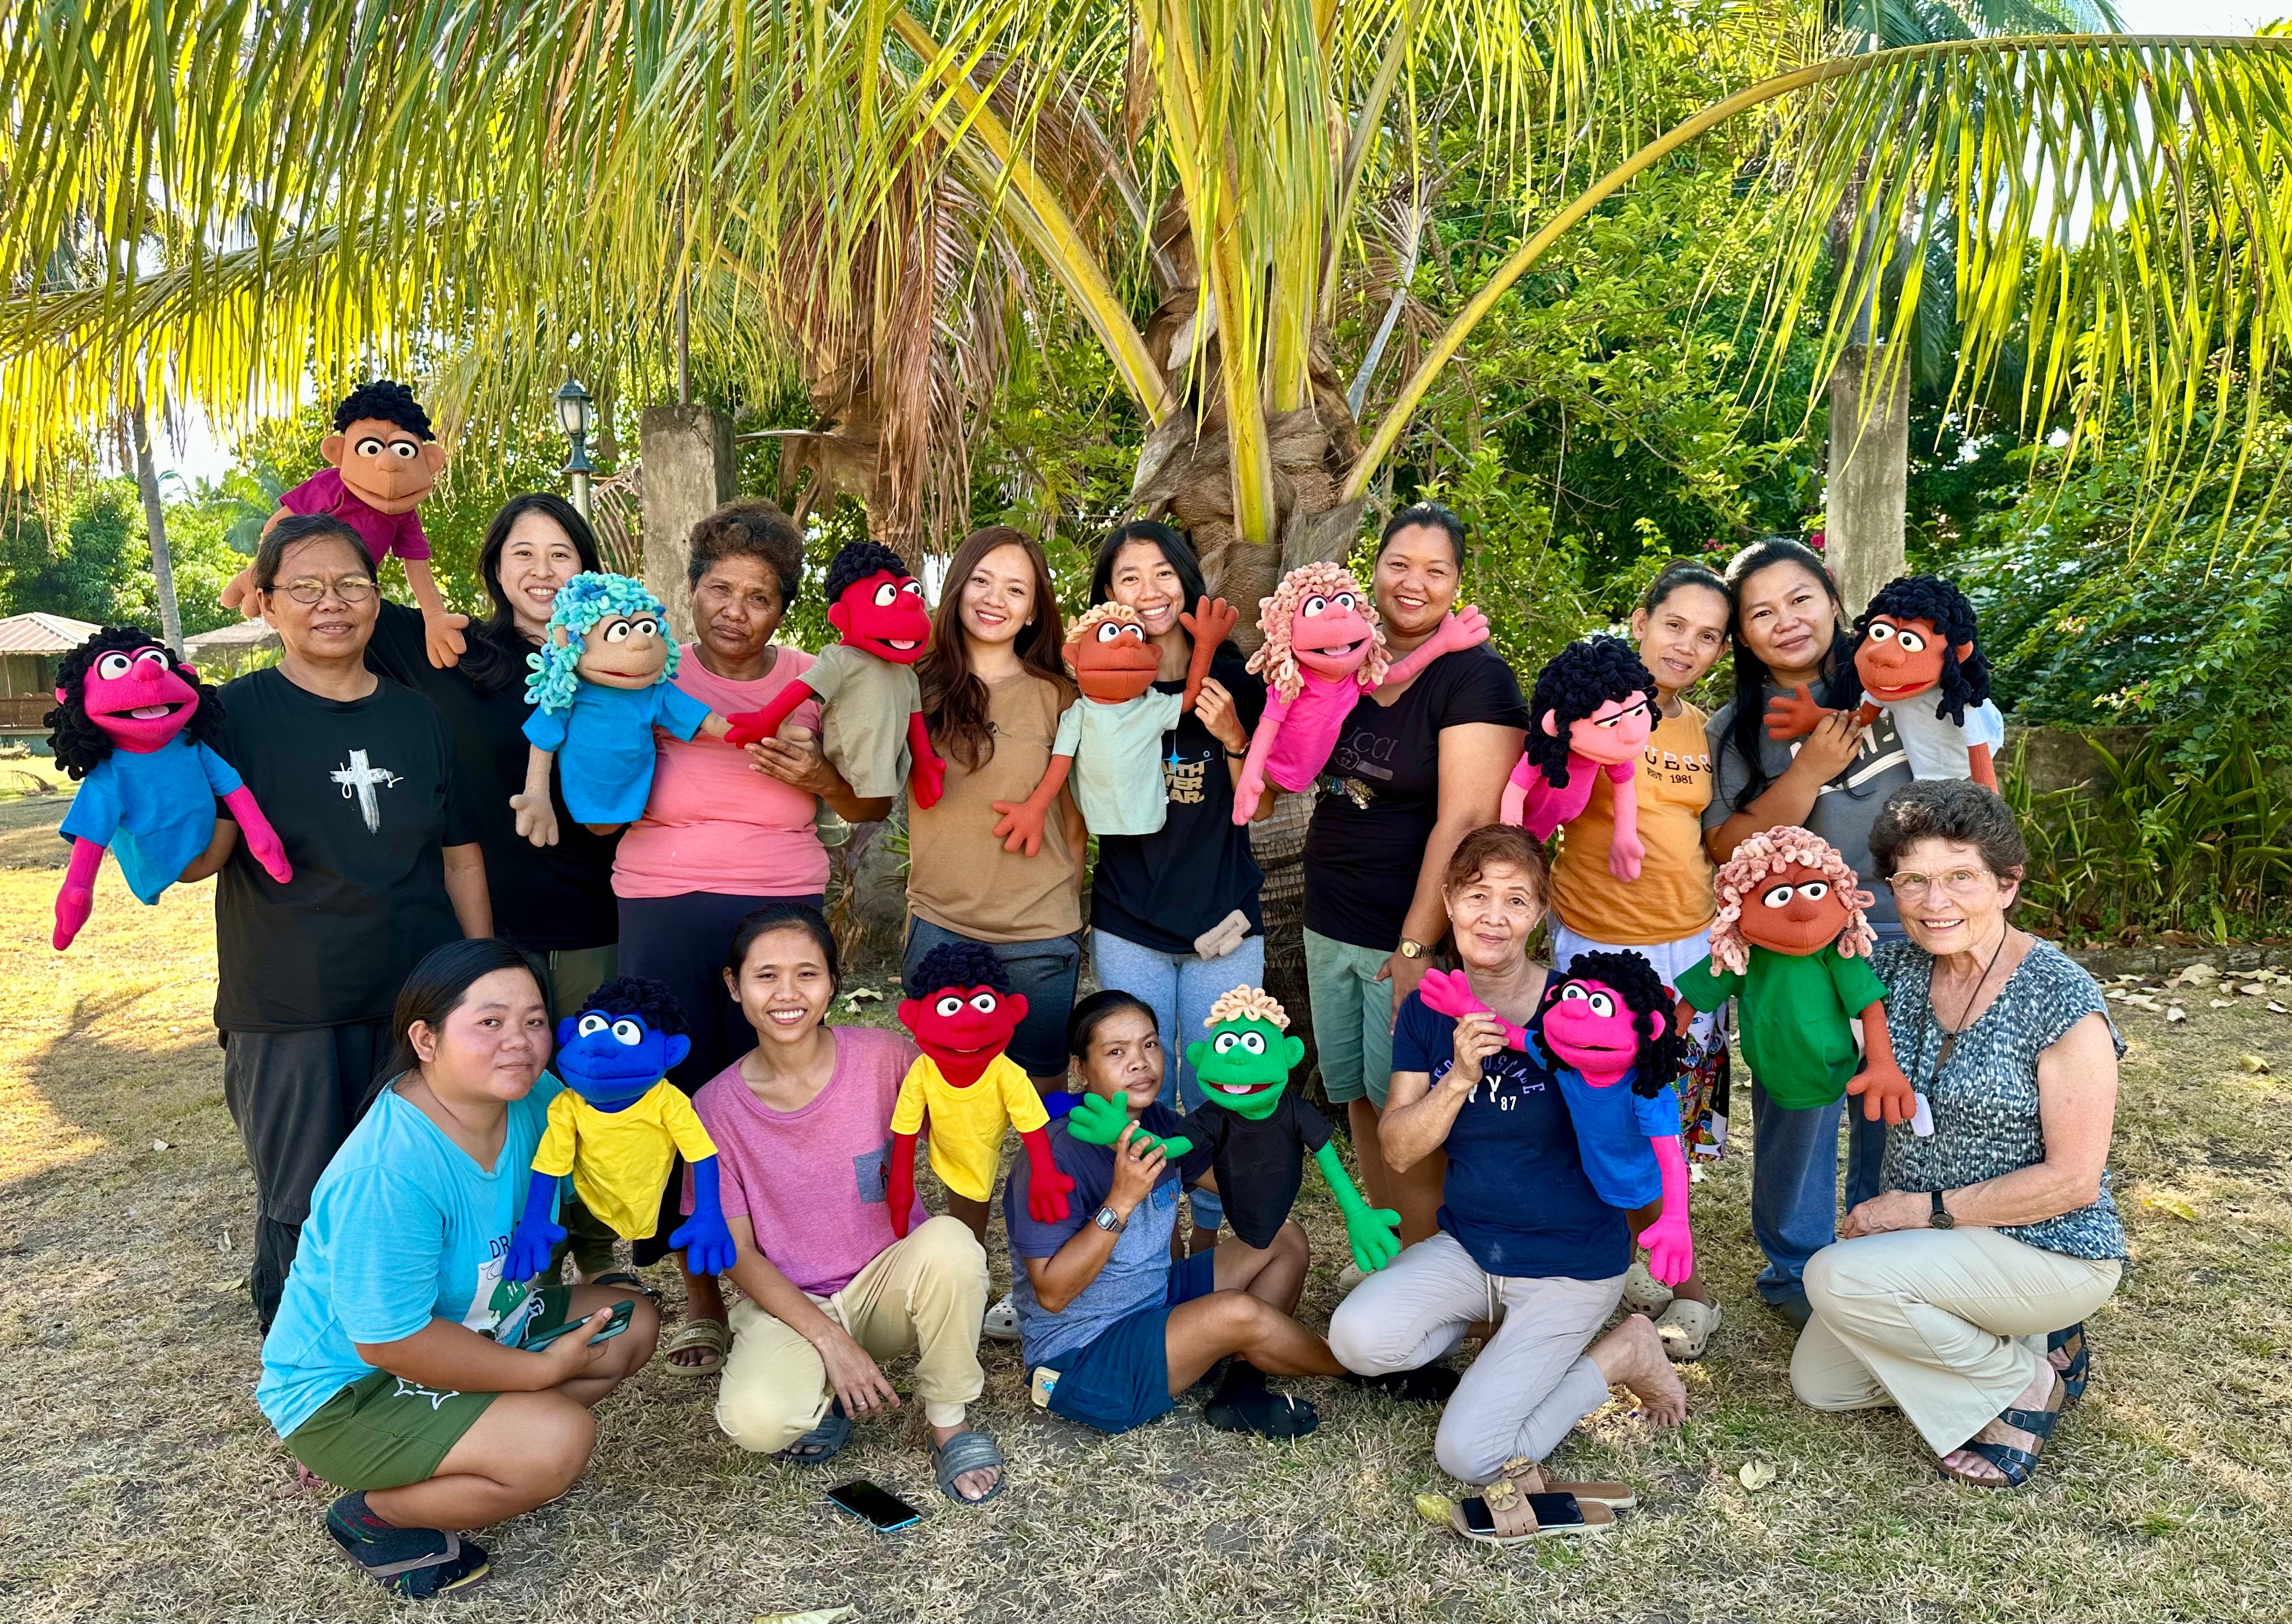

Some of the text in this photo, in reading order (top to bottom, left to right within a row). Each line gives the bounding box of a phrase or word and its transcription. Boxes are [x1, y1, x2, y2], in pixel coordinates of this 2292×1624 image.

[1339, 726, 1399, 762] UCCI
[1645, 745, 1713, 774] UESS
[1161, 760, 1205, 777] ITH
[1647, 767, 1694, 784] EST 1981
[1165, 774, 1203, 791] VER
[1468, 1075, 1502, 1103] Y
[1501, 1096, 1517, 1111] 87
